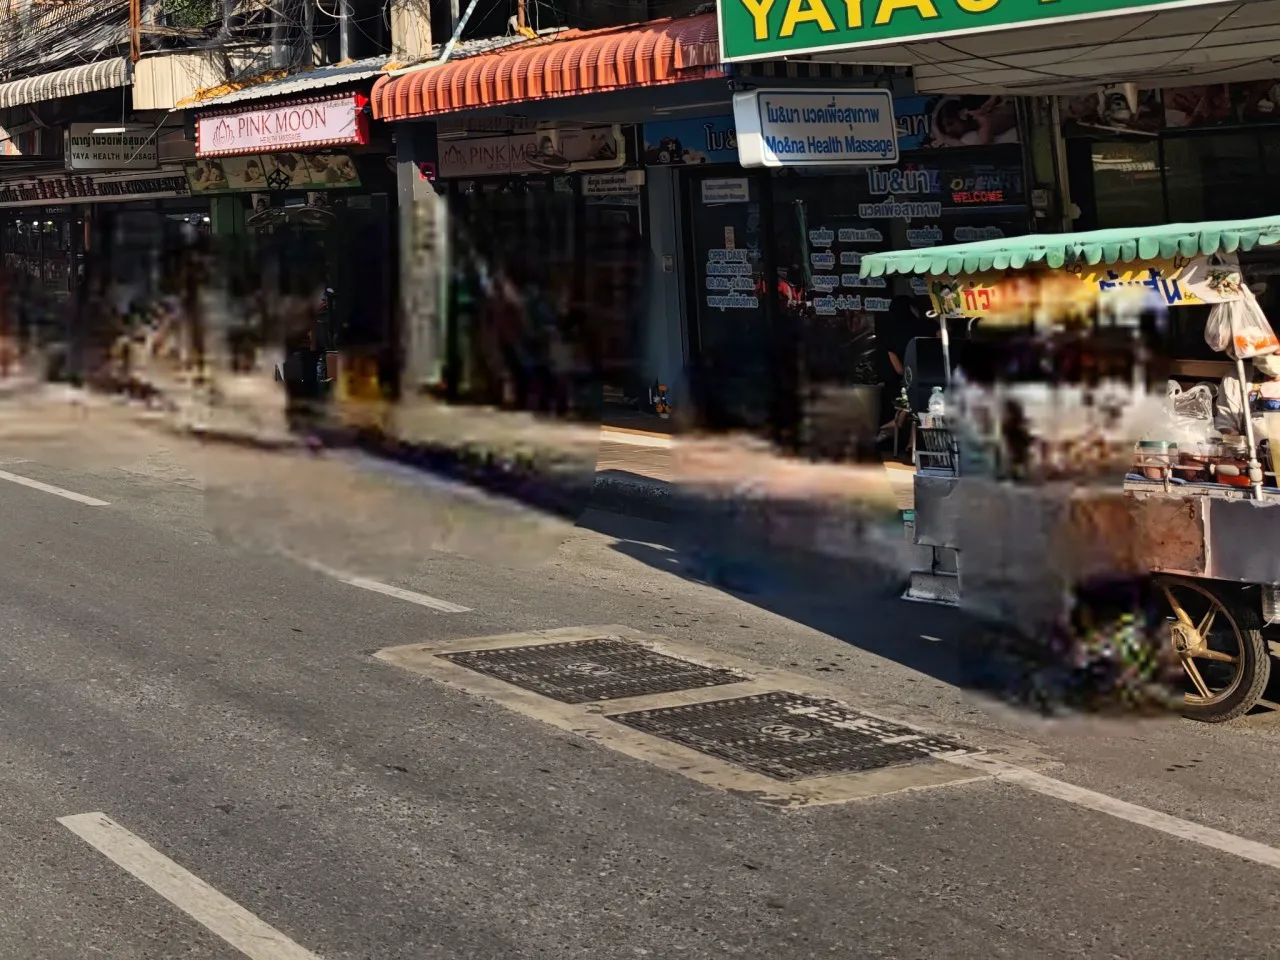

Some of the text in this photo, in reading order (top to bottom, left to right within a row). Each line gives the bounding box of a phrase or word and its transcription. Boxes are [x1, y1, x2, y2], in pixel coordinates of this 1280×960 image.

[238, 107, 327, 138] PINK MOON
[803, 96, 880, 131] นวดเพื่อสุขภาพ
[278, 134, 302, 143] MASSAGE
[765, 135, 893, 157] Mo&na Health Massage
[72, 152, 157, 160] YAYA HEALTH MASSAGE
[470, 145, 505, 165] PINK
[951, 190, 1004, 204] WELCOME
[858, 195, 942, 224] นวดเพื่อสุขภาพ
[708, 249, 747, 261] OPEN DAILY
